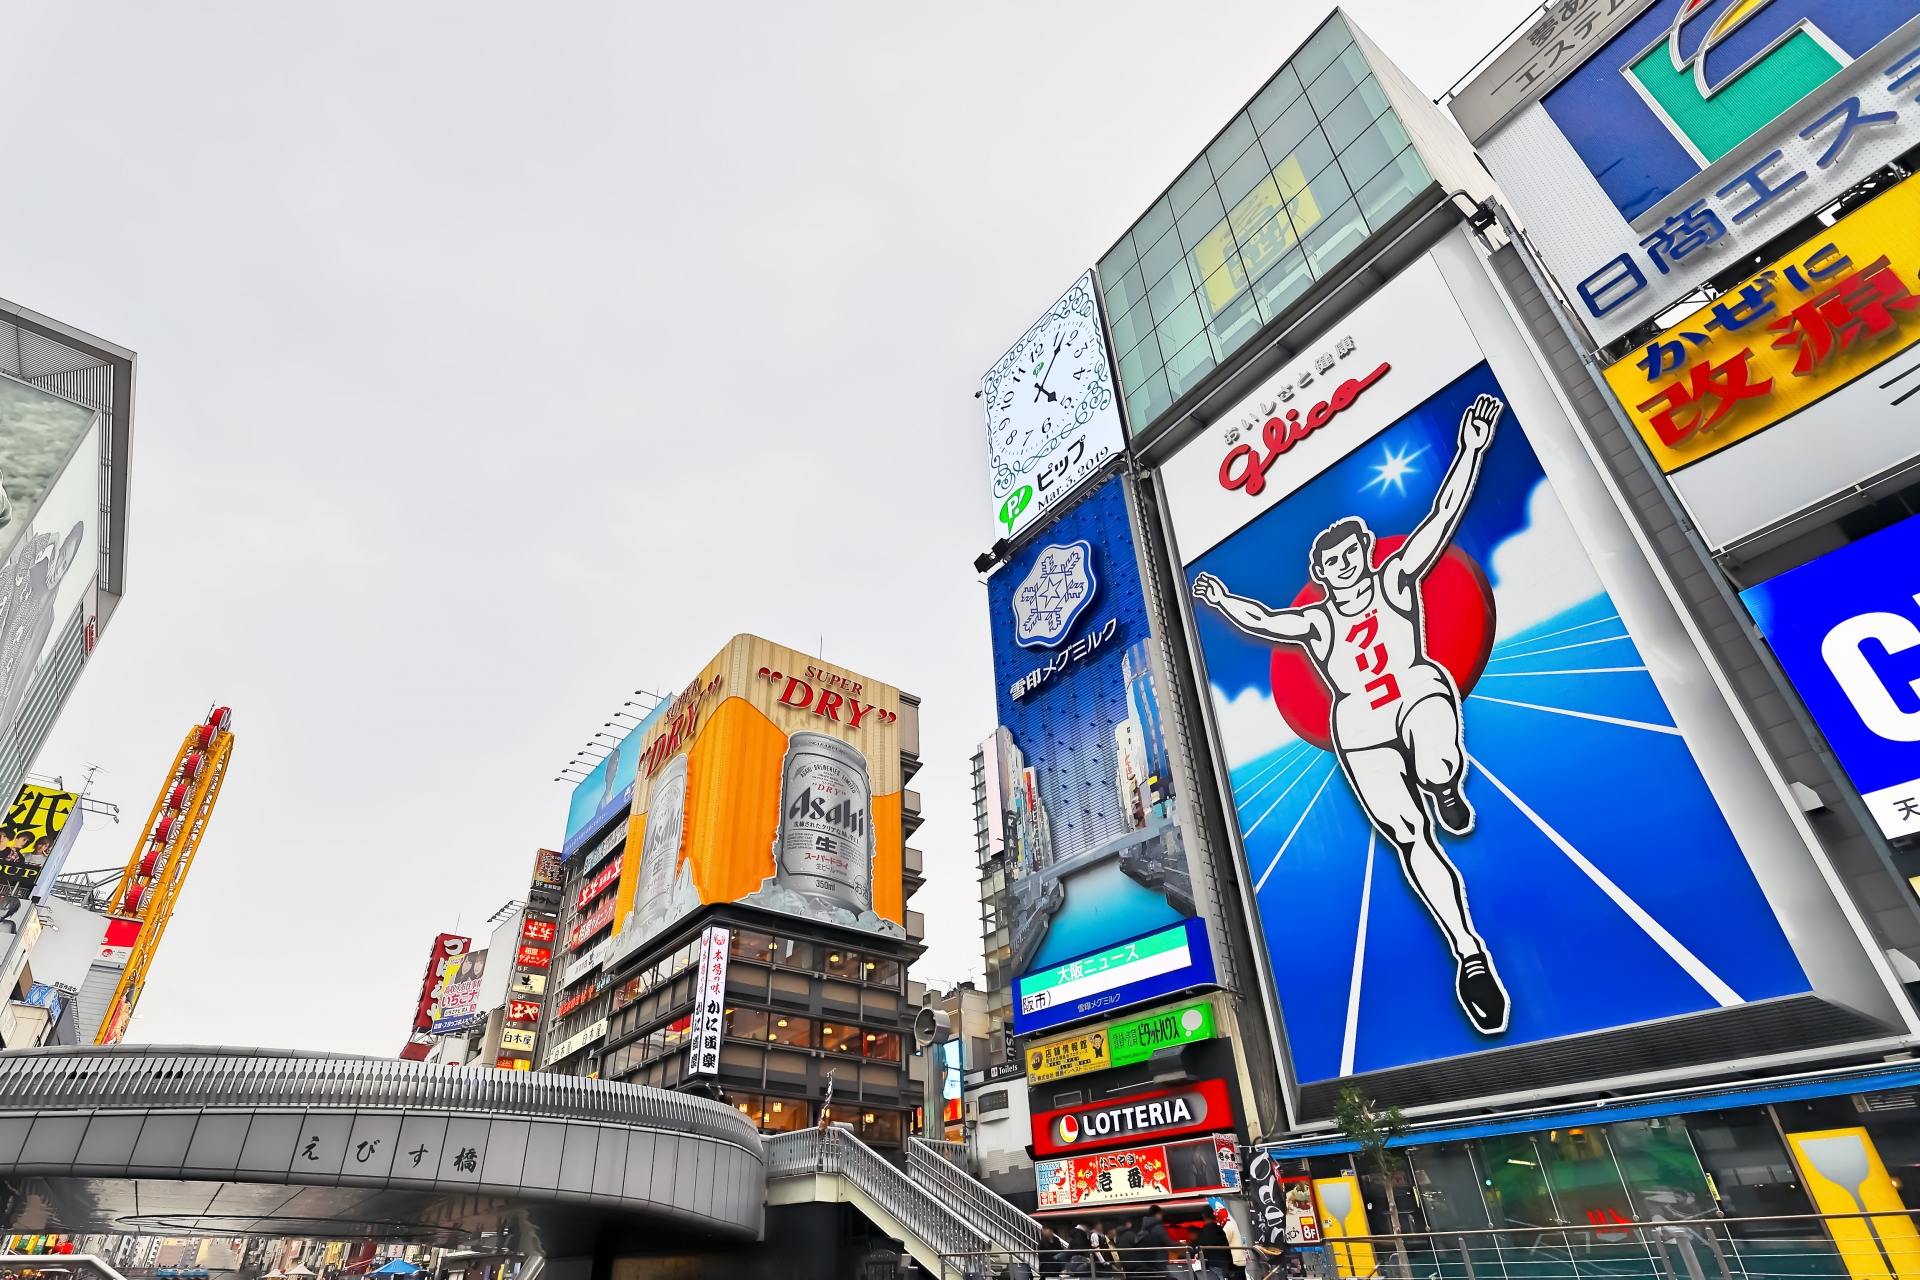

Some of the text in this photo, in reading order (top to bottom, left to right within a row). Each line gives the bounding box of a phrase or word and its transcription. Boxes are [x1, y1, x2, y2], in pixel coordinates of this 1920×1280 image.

[1526, 0, 1592, 48] 夢あ
[1636, 242, 1853, 384] かぜに
[1066, 329, 1080, 348] 2
[1029, 343, 1045, 364] 12
[1073, 342, 1089, 360] 3
[1636, 254, 1920, 449] 改源
[1012, 366, 1028, 385] 11
[1072, 366, 1087, 381] 4
[1224, 335, 1355, 445] おいしさと健康
[1000, 390, 1015, 412] 10
[1041, 417, 1052, 434] 6
[1005, 428, 1018, 447] 8
[1022, 429, 1035, 448] 7
[1037, 434, 1087, 492] ピップ
[1038, 485, 1063, 511] Mar.
[1077, 446, 1109, 477] 2019
[1010, 617, 1117, 701] 雪印メグミルク
[1345, 608, 1402, 711] グリコ
[803, 665, 863, 696] SUPER
[664, 677, 700, 725] SUPER
[789, 787, 864, 837] Asahi
[815, 836, 838, 855] 生
[804, 852, 849, 870] スーパードライ
[815, 879, 836, 892] 350ml
[524, 924, 554, 941] 笑笑
[518, 953, 549, 966] ダイニング
[1057, 944, 1140, 985] 大阪ニュース
[711, 949, 723, 995] 本場の味
[509, 1003, 539, 1021] はや
[1077, 993, 1121, 1013] 雪印メグミルク
[503, 1031, 532, 1046] 白木屋
[1138, 1016, 1180, 1047] ピタットハウス
[999, 1064, 1018, 1075] Toilets
[1082, 1098, 1192, 1137] LOTTERIA
[302, 1136, 478, 1173] えびす橋
[1100, 1152, 1135, 1169] たこやき
[1068, 1160, 1078, 1203] TAKOYAKI
[1099, 1166, 1142, 1192] 壱番
[1303, 1225, 1316, 1239] 8F
